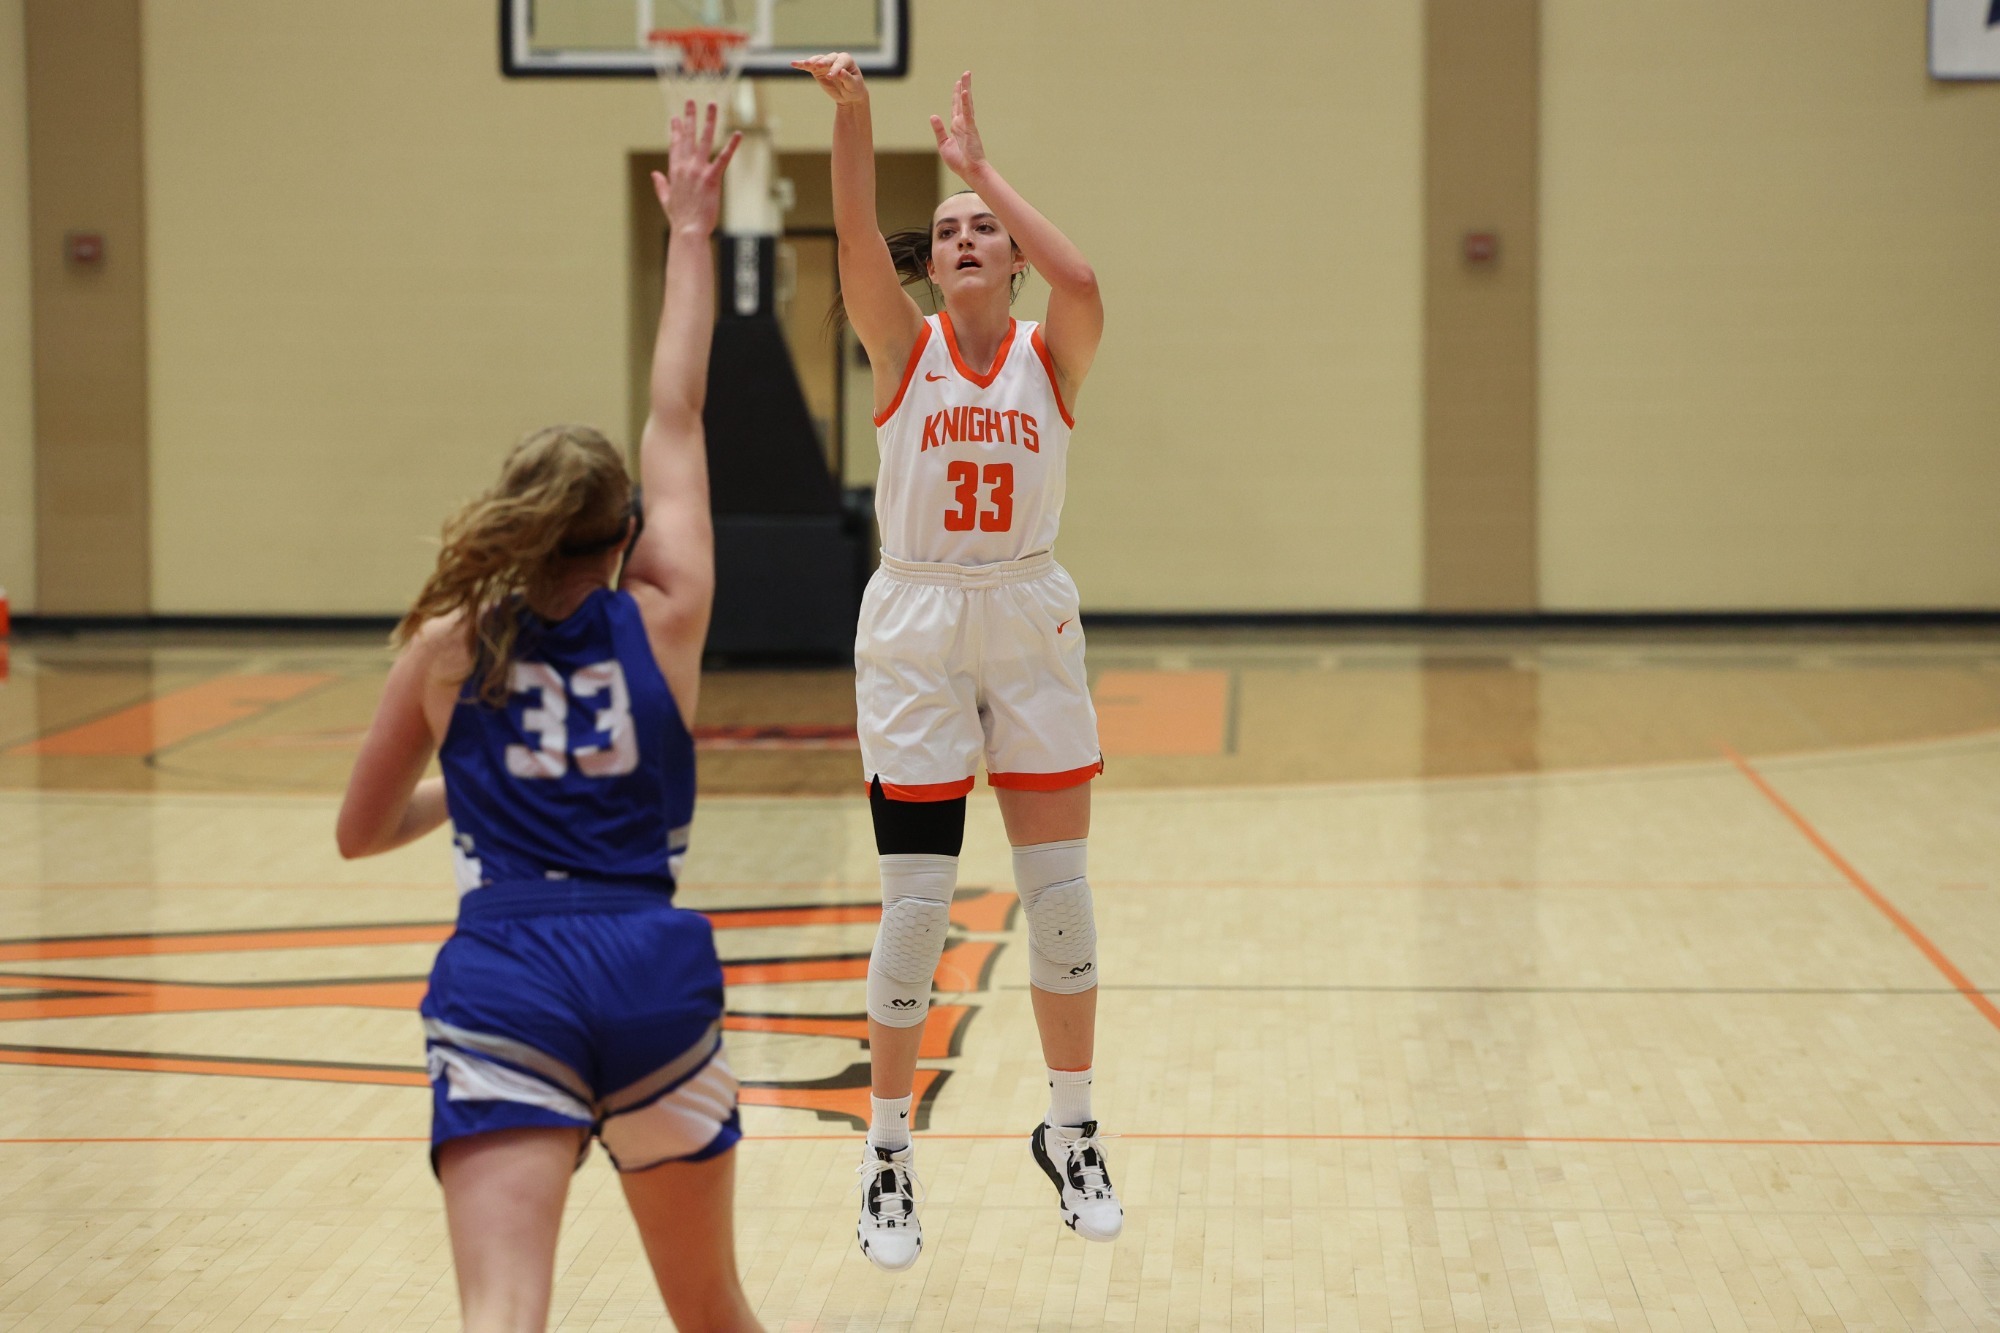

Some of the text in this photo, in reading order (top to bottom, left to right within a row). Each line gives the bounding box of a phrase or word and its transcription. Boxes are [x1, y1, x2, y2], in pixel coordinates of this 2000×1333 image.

[921, 406, 1040, 453] KNIGHTS
[944, 461, 1013, 532] 33
[505, 660, 639, 778] 33
